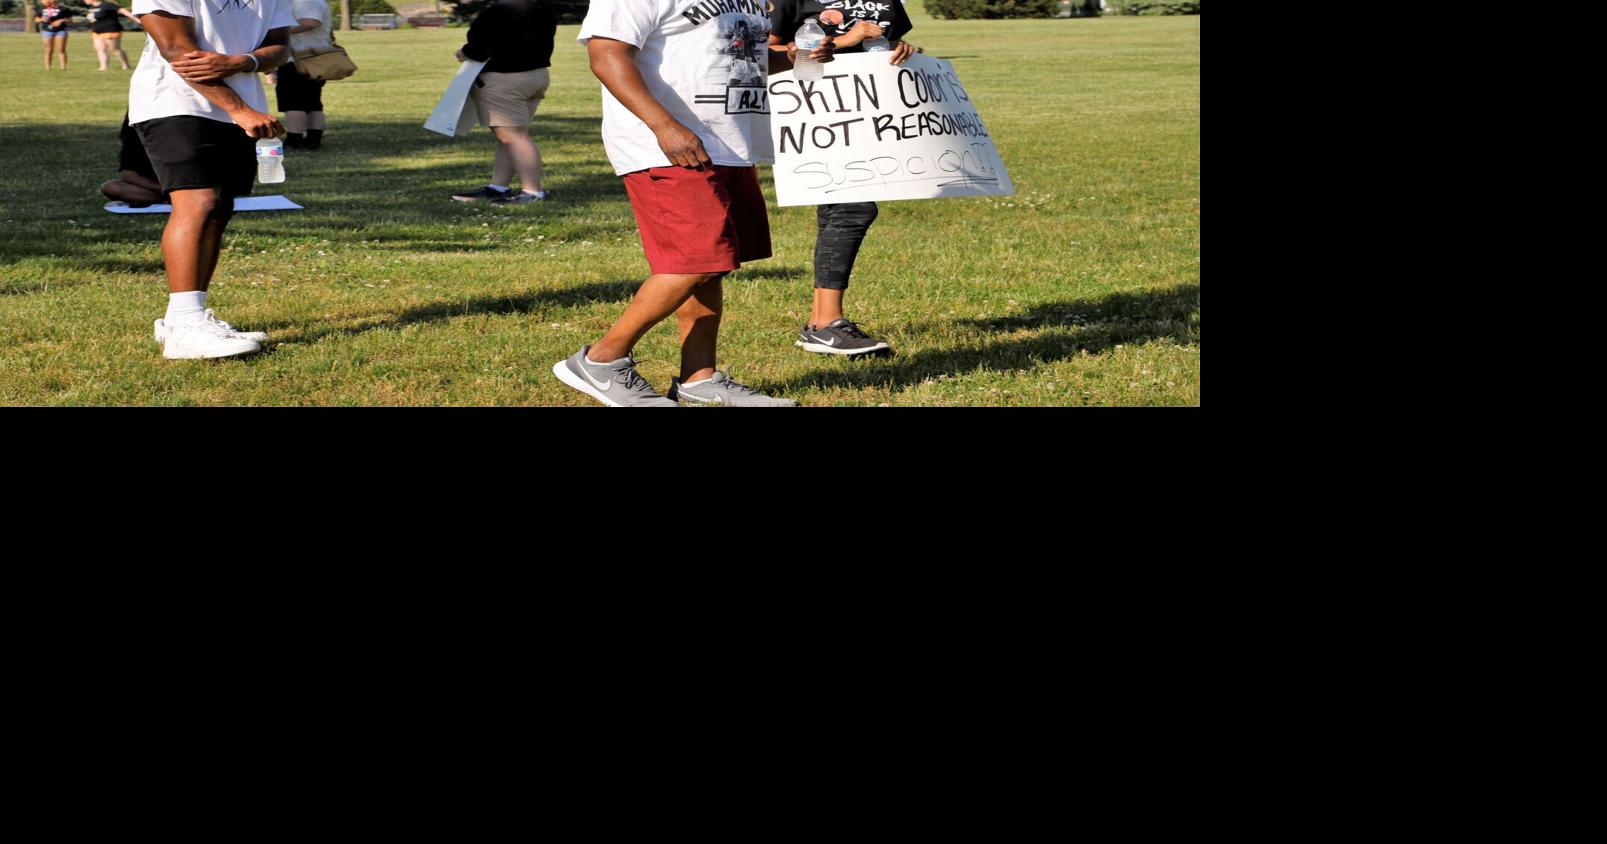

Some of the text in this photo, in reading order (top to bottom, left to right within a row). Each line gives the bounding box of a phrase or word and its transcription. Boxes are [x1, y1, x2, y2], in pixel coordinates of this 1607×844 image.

[850, 10, 867, 18] IS
[779, 111, 988, 154] NOT REASONABLE
